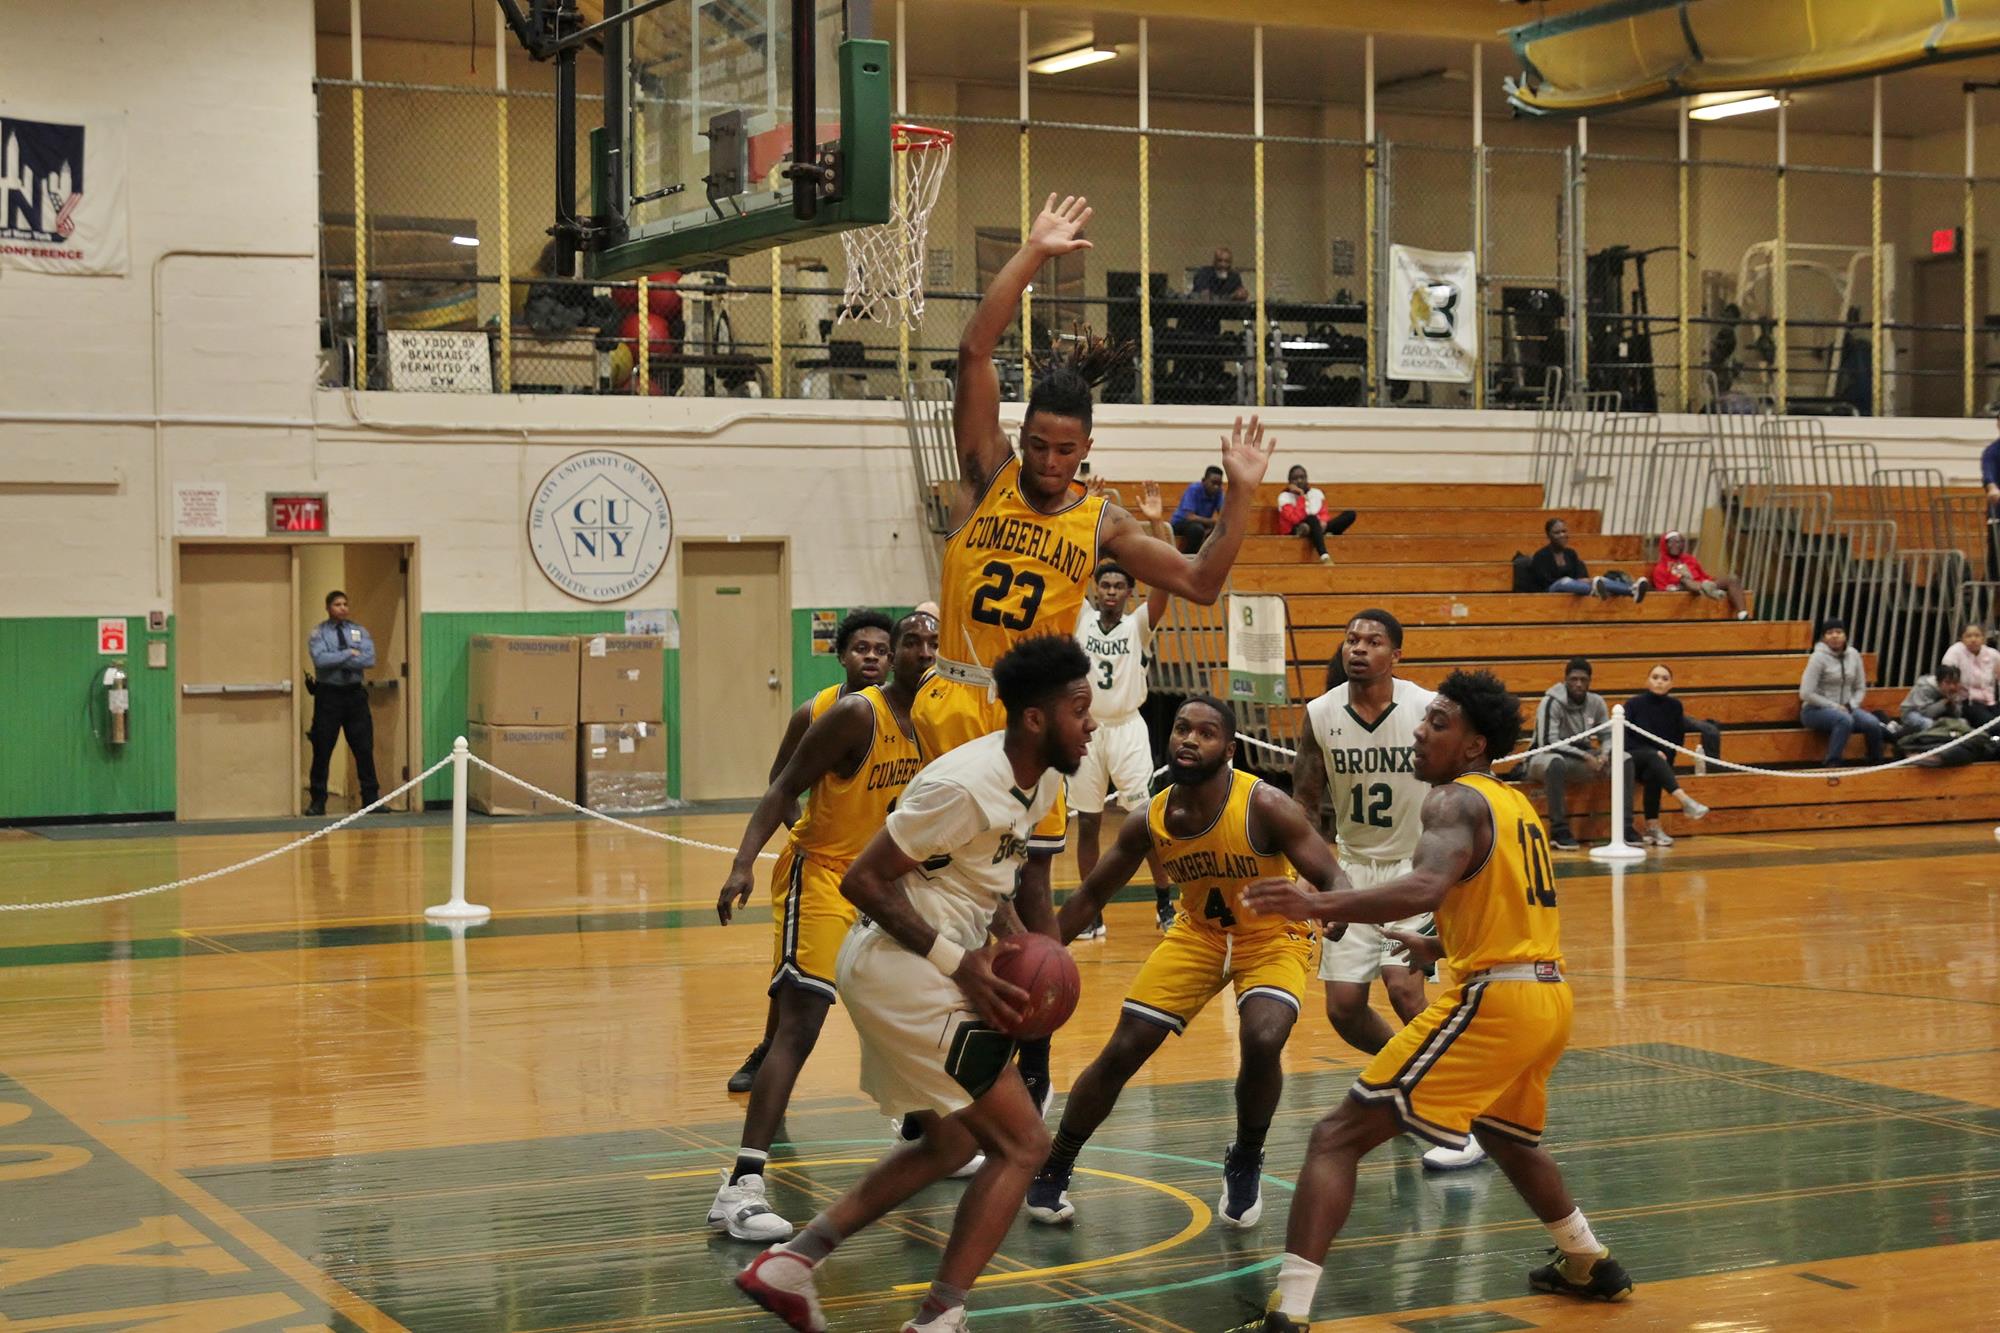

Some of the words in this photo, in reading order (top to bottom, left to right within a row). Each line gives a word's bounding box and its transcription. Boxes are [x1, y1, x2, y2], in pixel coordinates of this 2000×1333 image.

[402, 338, 417, 348] NO
[424, 338, 456, 349] FOOD
[461, 338, 476, 348] OR
[408, 350, 471, 361] BEVERAGES
[400, 362, 461, 373] PERMITTED
[469, 364, 480, 373] IN
[430, 377, 454, 386] GYM
[533, 504, 545, 529] THE
[540, 479, 558, 505] CITY
[558, 456, 620, 480] UNIVERSITY
[623, 462, 637, 475] OF
[638, 471, 657, 494] NEW
[654, 497, 668, 529] YORK
[273, 503, 321, 531] EXIT
[966, 516, 1088, 584] CUMBERLAND
[545, 562, 589, 595] ATHLETIC
[593, 563, 657, 598] CONFERENCE
[971, 560, 1045, 632] 23
[1086, 635, 1131, 656] BRONX
[1098, 661, 1114, 690] 3
[867, 758, 922, 791] CUMBER
[1331, 746, 1416, 774] BRONX
[1350, 782, 1393, 828] 12
[1518, 818, 1557, 908] 10
[1204, 887, 1237, 928] 4
